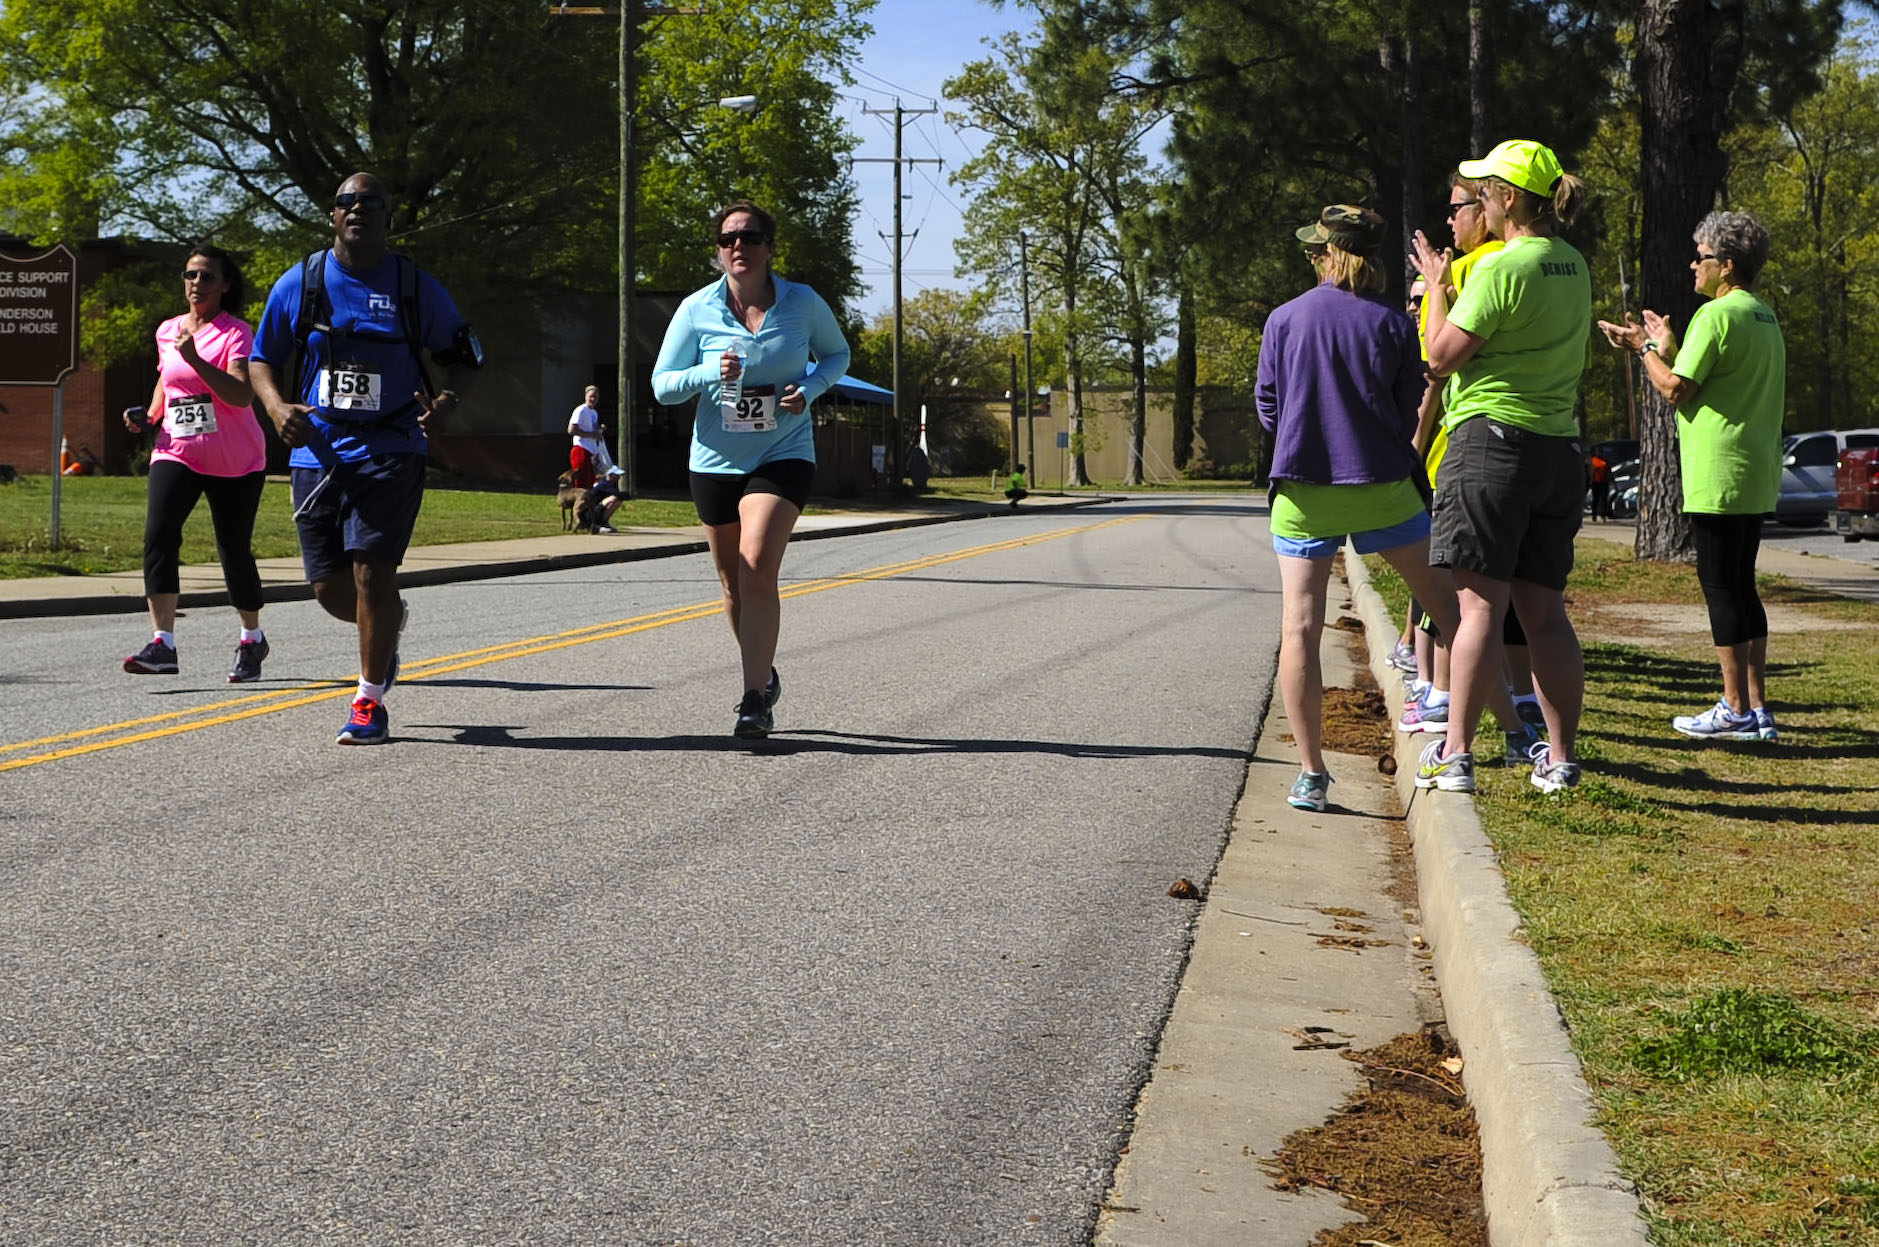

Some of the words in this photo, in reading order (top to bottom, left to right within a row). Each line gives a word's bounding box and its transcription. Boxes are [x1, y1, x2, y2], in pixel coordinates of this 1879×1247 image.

[17, 271, 70, 283] SUPPORT
[0, 286, 47, 298] DIVISION
[19, 322, 59, 334] HOUSE
[332, 372, 370, 395] 158
[174, 404, 208, 425] 254
[736, 397, 764, 419] 92
